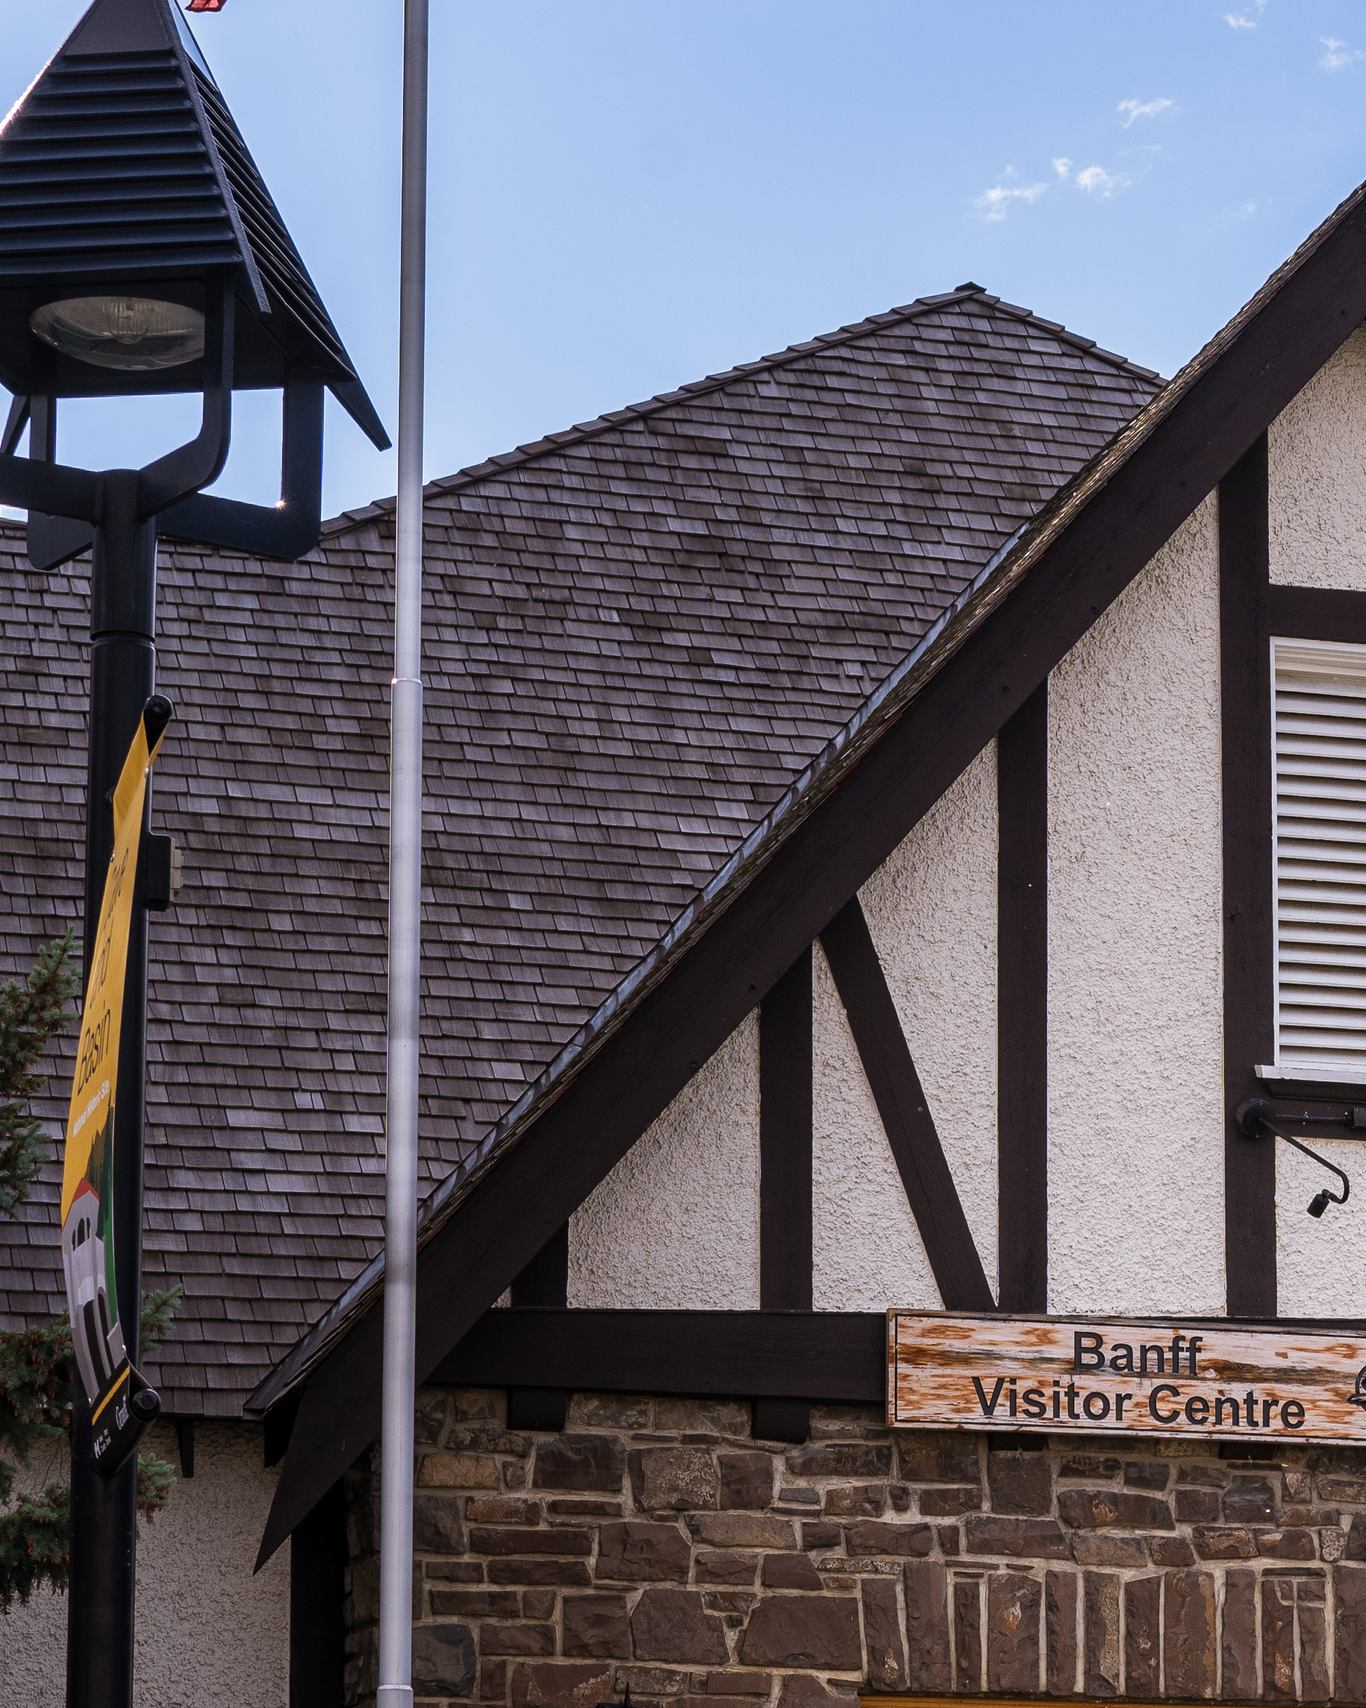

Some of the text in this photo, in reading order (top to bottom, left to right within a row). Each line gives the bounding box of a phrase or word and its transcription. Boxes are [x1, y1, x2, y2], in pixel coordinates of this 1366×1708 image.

[77, 1000, 111, 1096] Basin
[1074, 1330, 1204, 1376] Banff
[971, 1375, 1306, 1429] Visitor Centre
